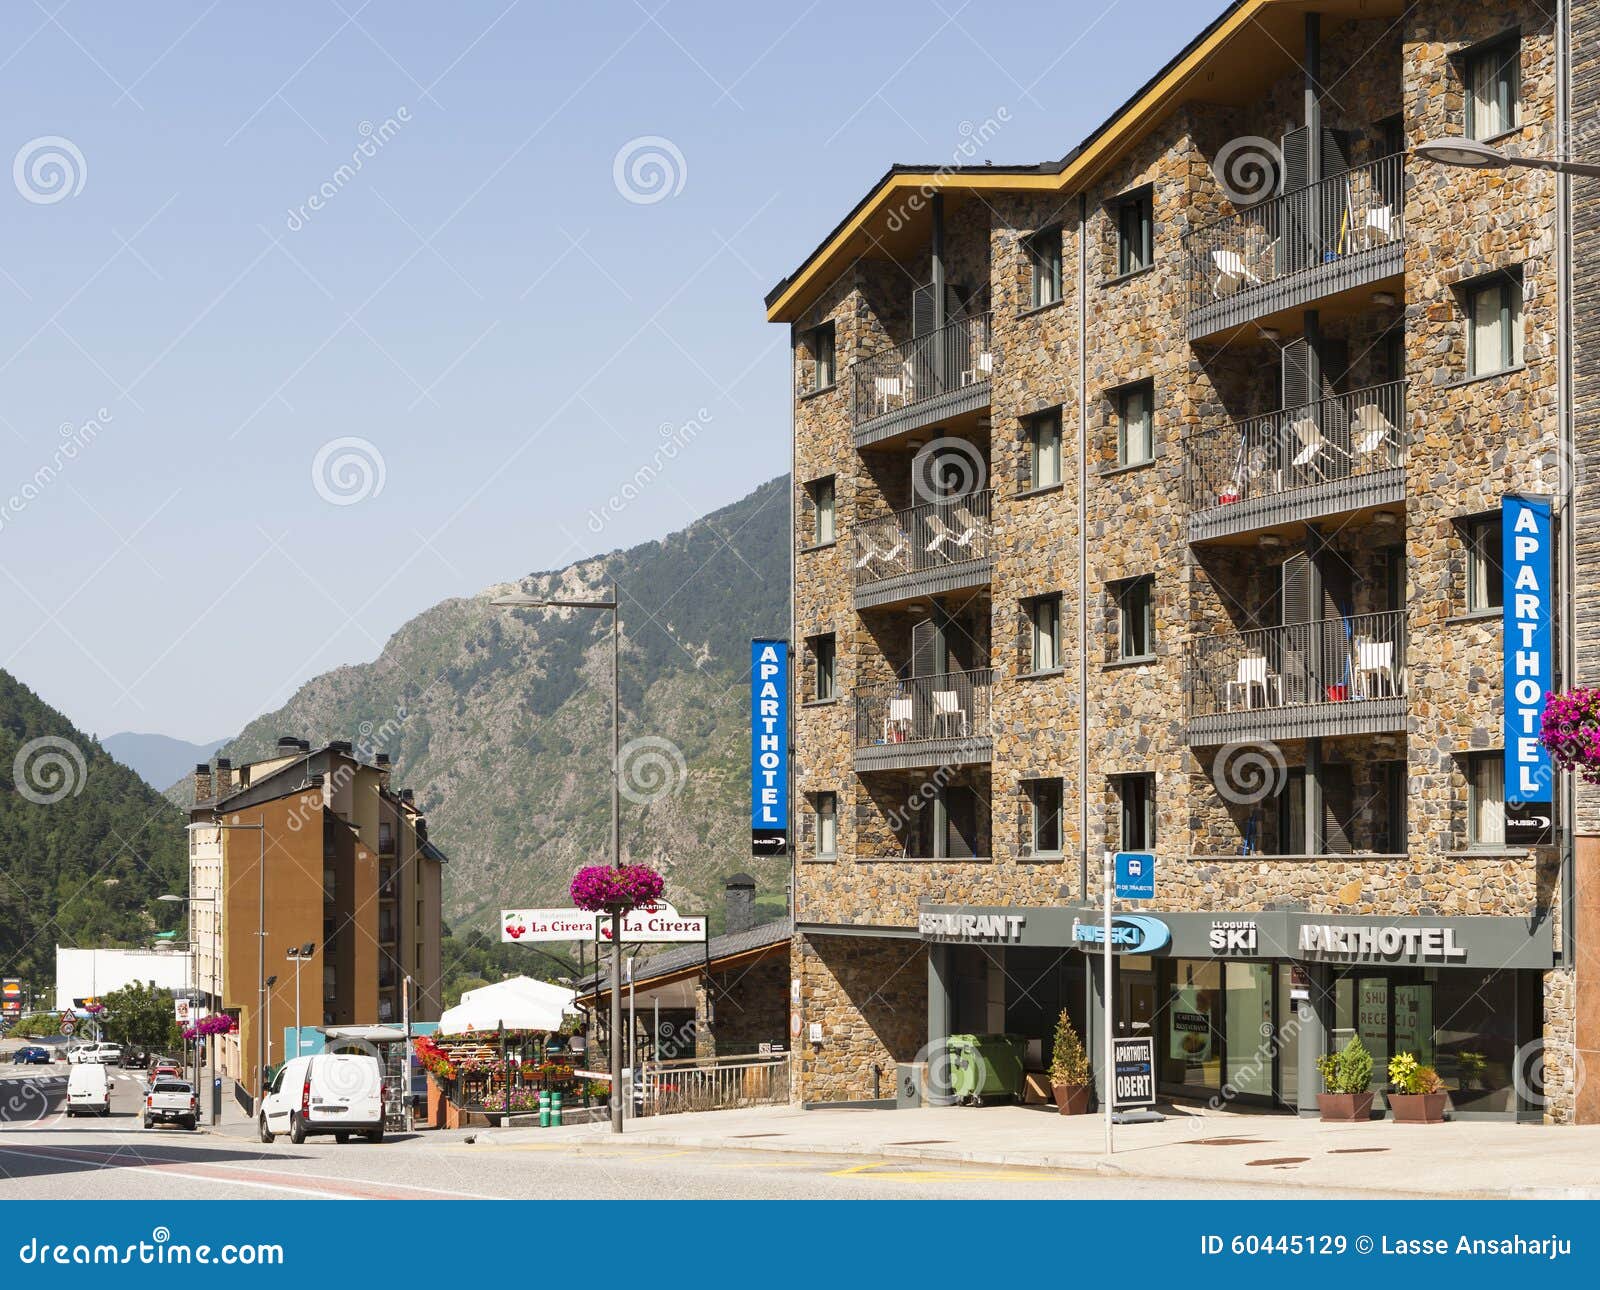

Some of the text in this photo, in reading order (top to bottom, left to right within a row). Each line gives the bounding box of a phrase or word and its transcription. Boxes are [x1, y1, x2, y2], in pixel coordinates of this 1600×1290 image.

[1514, 508, 1541, 792] APARTHOTEL
[760, 646, 780, 822] APARTHOTEL
[532, 920, 592, 932] La Cirera
[623, 918, 701, 932] La Cirera
[1212, 921, 1256, 929] LLOGUER
[1209, 930, 1257, 949] SKI
[1299, 924, 1468, 956] APARTHOTEL
[1116, 1045, 1150, 1062] APARTHOTEL
[1117, 1075, 1150, 1098] OBERT
